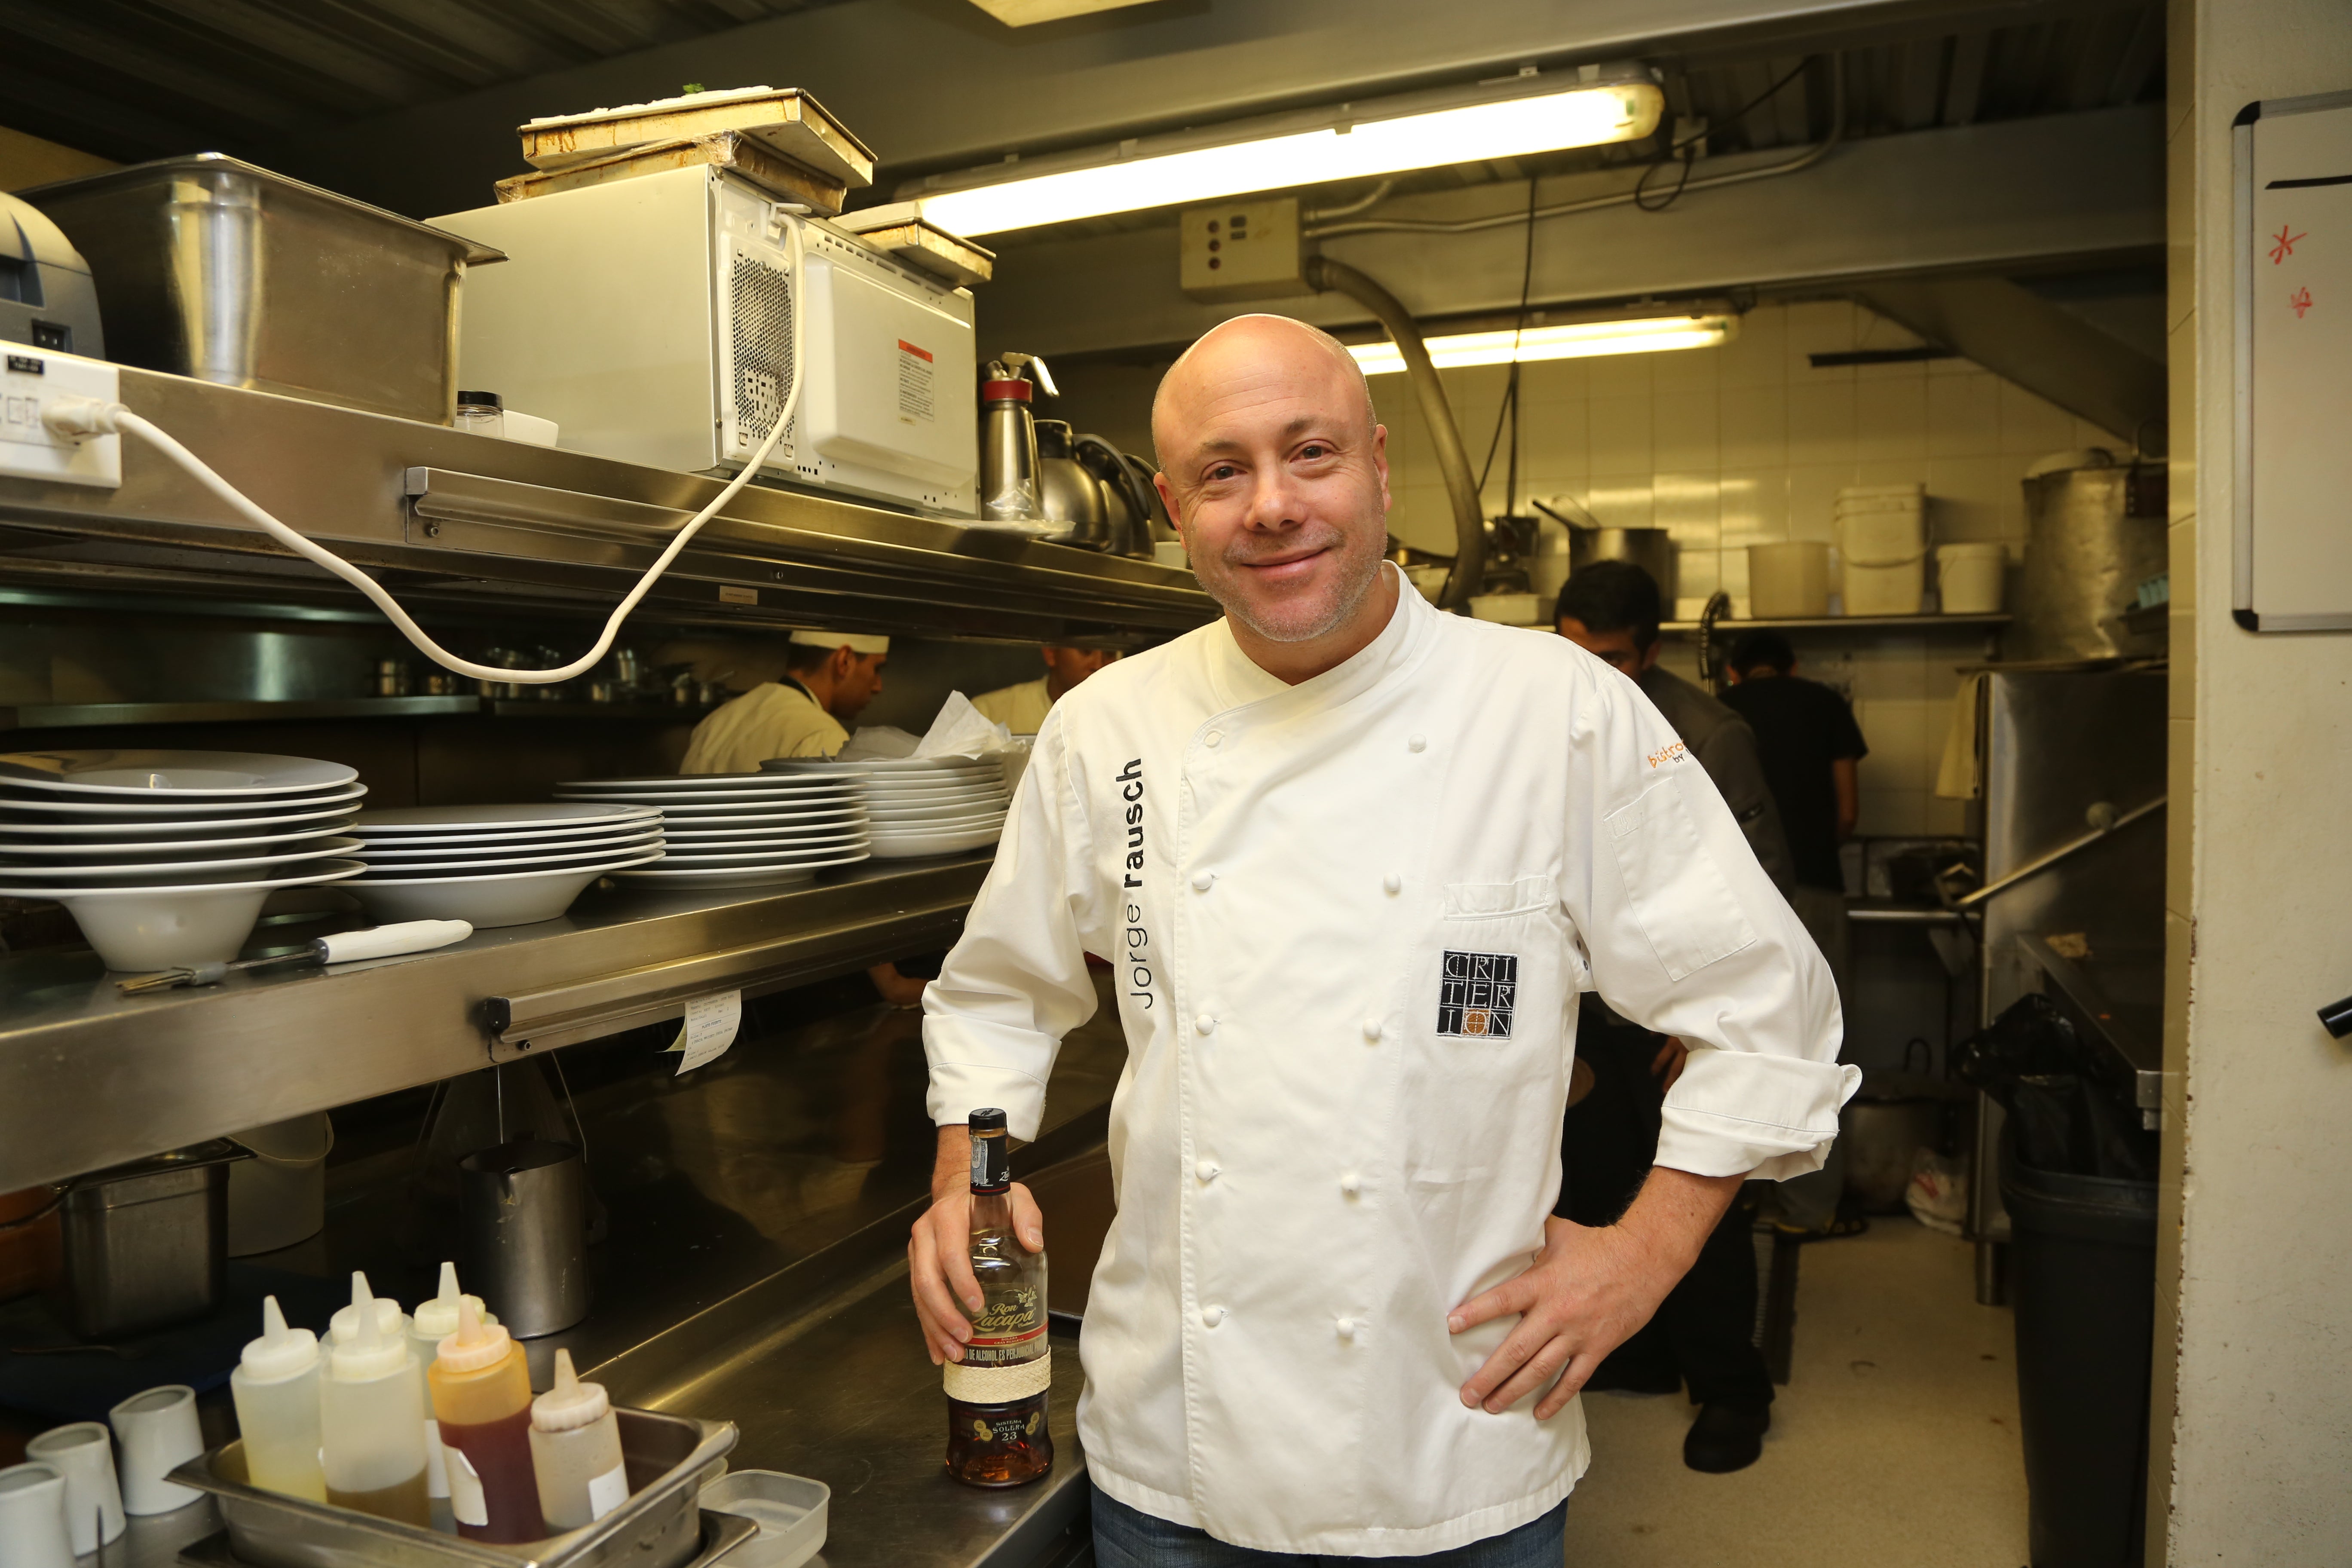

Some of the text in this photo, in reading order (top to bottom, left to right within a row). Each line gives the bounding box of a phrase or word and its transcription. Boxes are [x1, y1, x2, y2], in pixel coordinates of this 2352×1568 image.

[1647, 738, 1687, 769] bistro
[1672, 753, 1685, 763] by
[1116, 758, 1153, 1009] Jorge rausch
[989, 1303, 1018, 1315] Ron
[969, 1349, 975, 1360] DE
[976, 1349, 998, 1361] ALCOHOL
[999, 1349, 1005, 1360] ES
[1006, 1344, 1034, 1360] PERJUDICIAL
[992, 1424, 1025, 1433] SOLERA
[1001, 1432, 1017, 1441] 23
